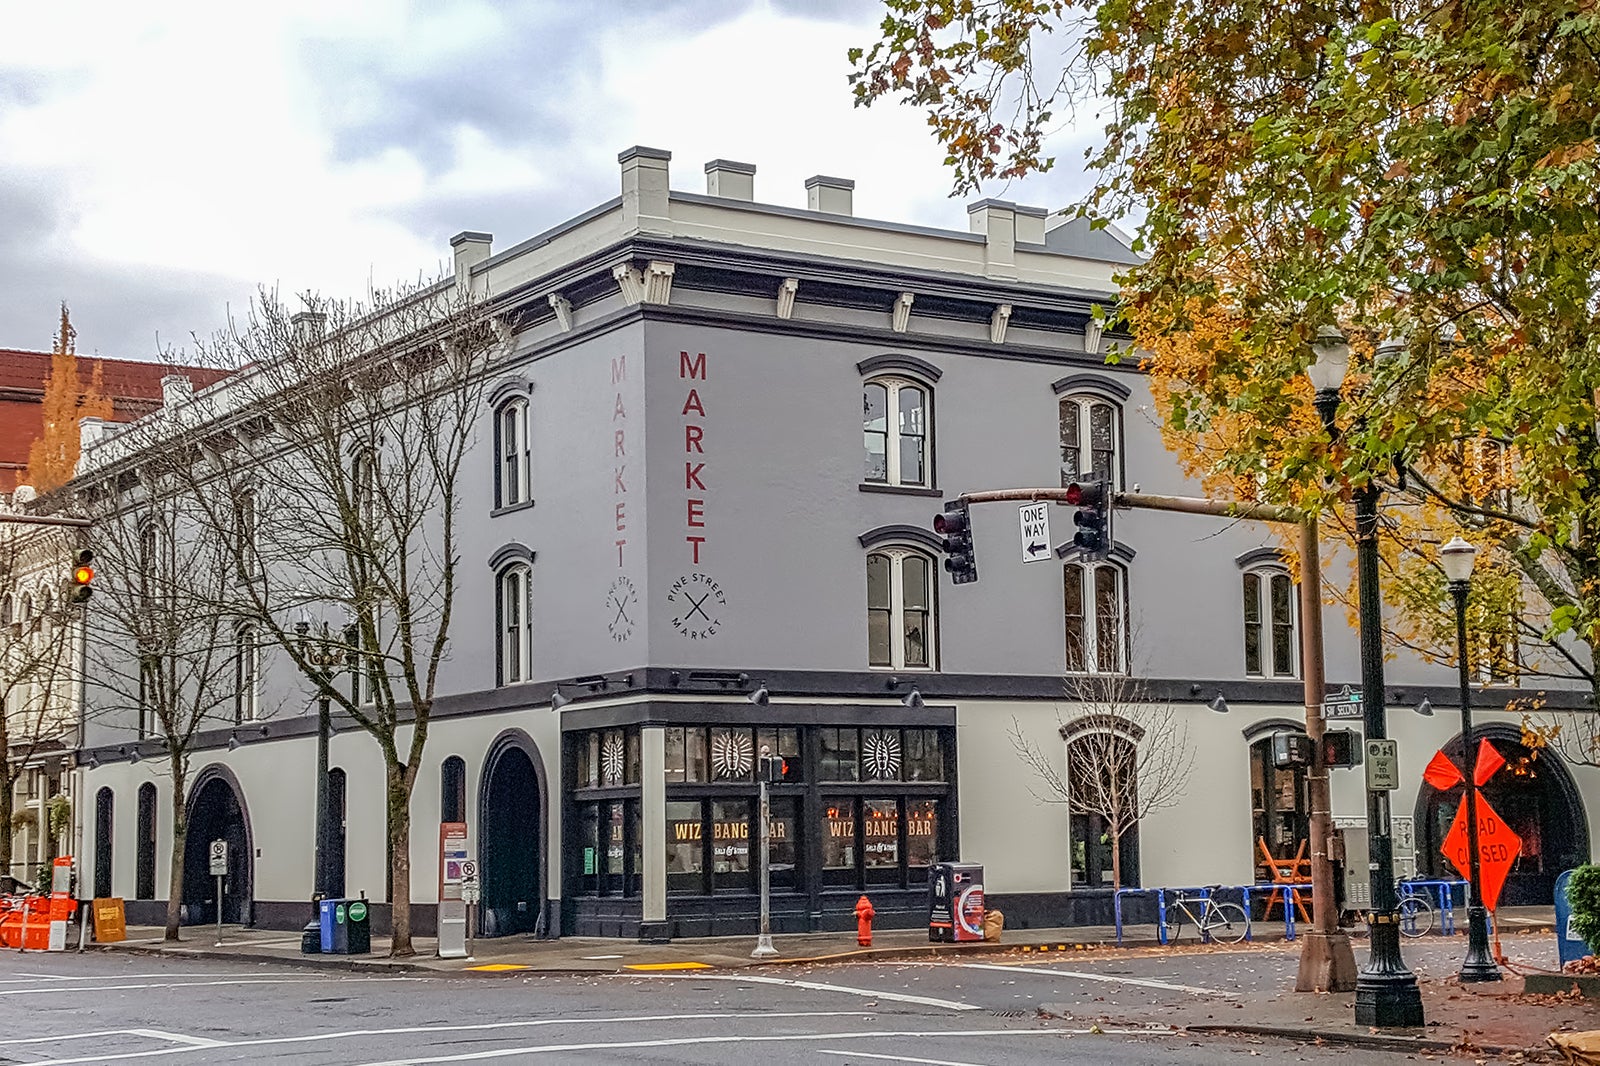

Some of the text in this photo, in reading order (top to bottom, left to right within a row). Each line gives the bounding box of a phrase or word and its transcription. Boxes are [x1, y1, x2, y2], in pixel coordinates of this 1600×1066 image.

[611, 355, 627, 567] MARKET
[680, 350, 707, 564] MARKET
[1024, 507, 1044, 522] ONE
[1024, 523, 1045, 537] WAY
[668, 573, 726, 605] PINE STREET
[672, 618, 721, 640] MARKET
[1337, 704, 1358, 715] SECOND
[675, 822, 785, 839] WIZ BANG AR
[830, 820, 931, 836] WIZ BANG BAR
[1460, 818, 1496, 838] RAD
[1457, 843, 1508, 865] CLSED
